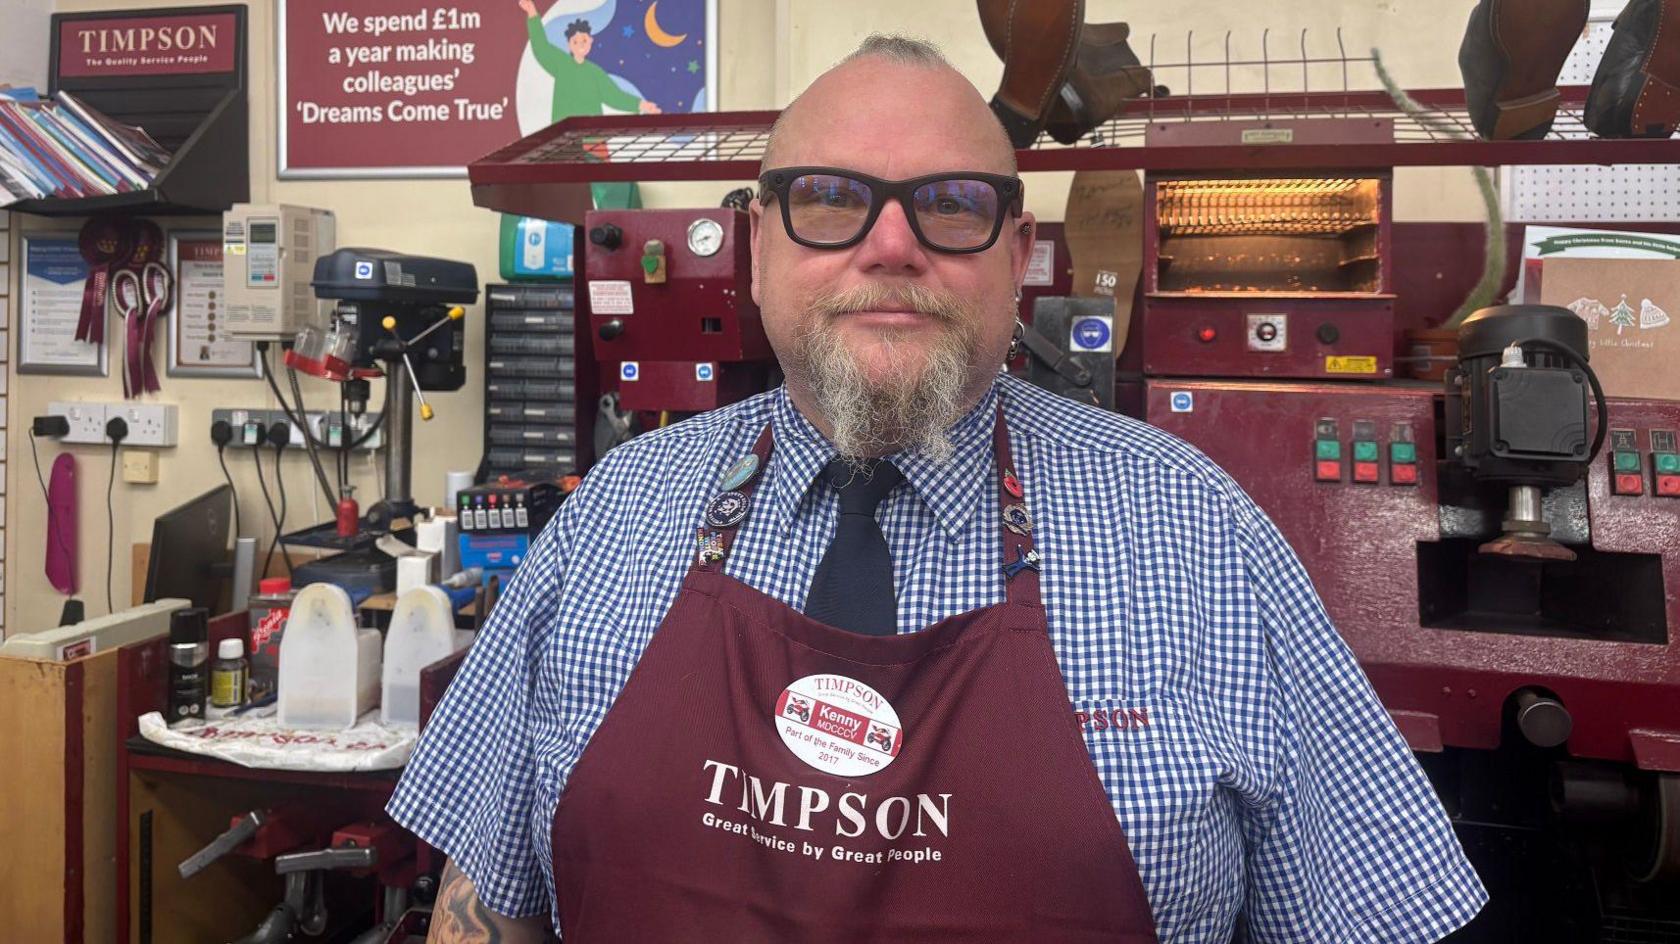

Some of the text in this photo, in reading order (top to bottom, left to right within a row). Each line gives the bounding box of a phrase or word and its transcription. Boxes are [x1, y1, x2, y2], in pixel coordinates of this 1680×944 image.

[322, 7, 481, 37] We spend £1m
[78, 24, 217, 53] TIMPSON
[328, 38, 476, 67] a year making
[86, 54, 208, 66] The Quality Service People
[343, 68, 460, 96] colleagues’
[296, 97, 509, 124] ‘Dreams Come True’
[814, 678, 884, 711] TIMPSON
[816, 719, 858, 740] MDCCCV
[820, 705, 862, 731] Kenny
[785, 726, 880, 767] Part of the Family Since
[818, 751, 840, 765] 2017
[703, 759, 953, 841] TIMPSON
[702, 812, 943, 864] Great Service by Great People
